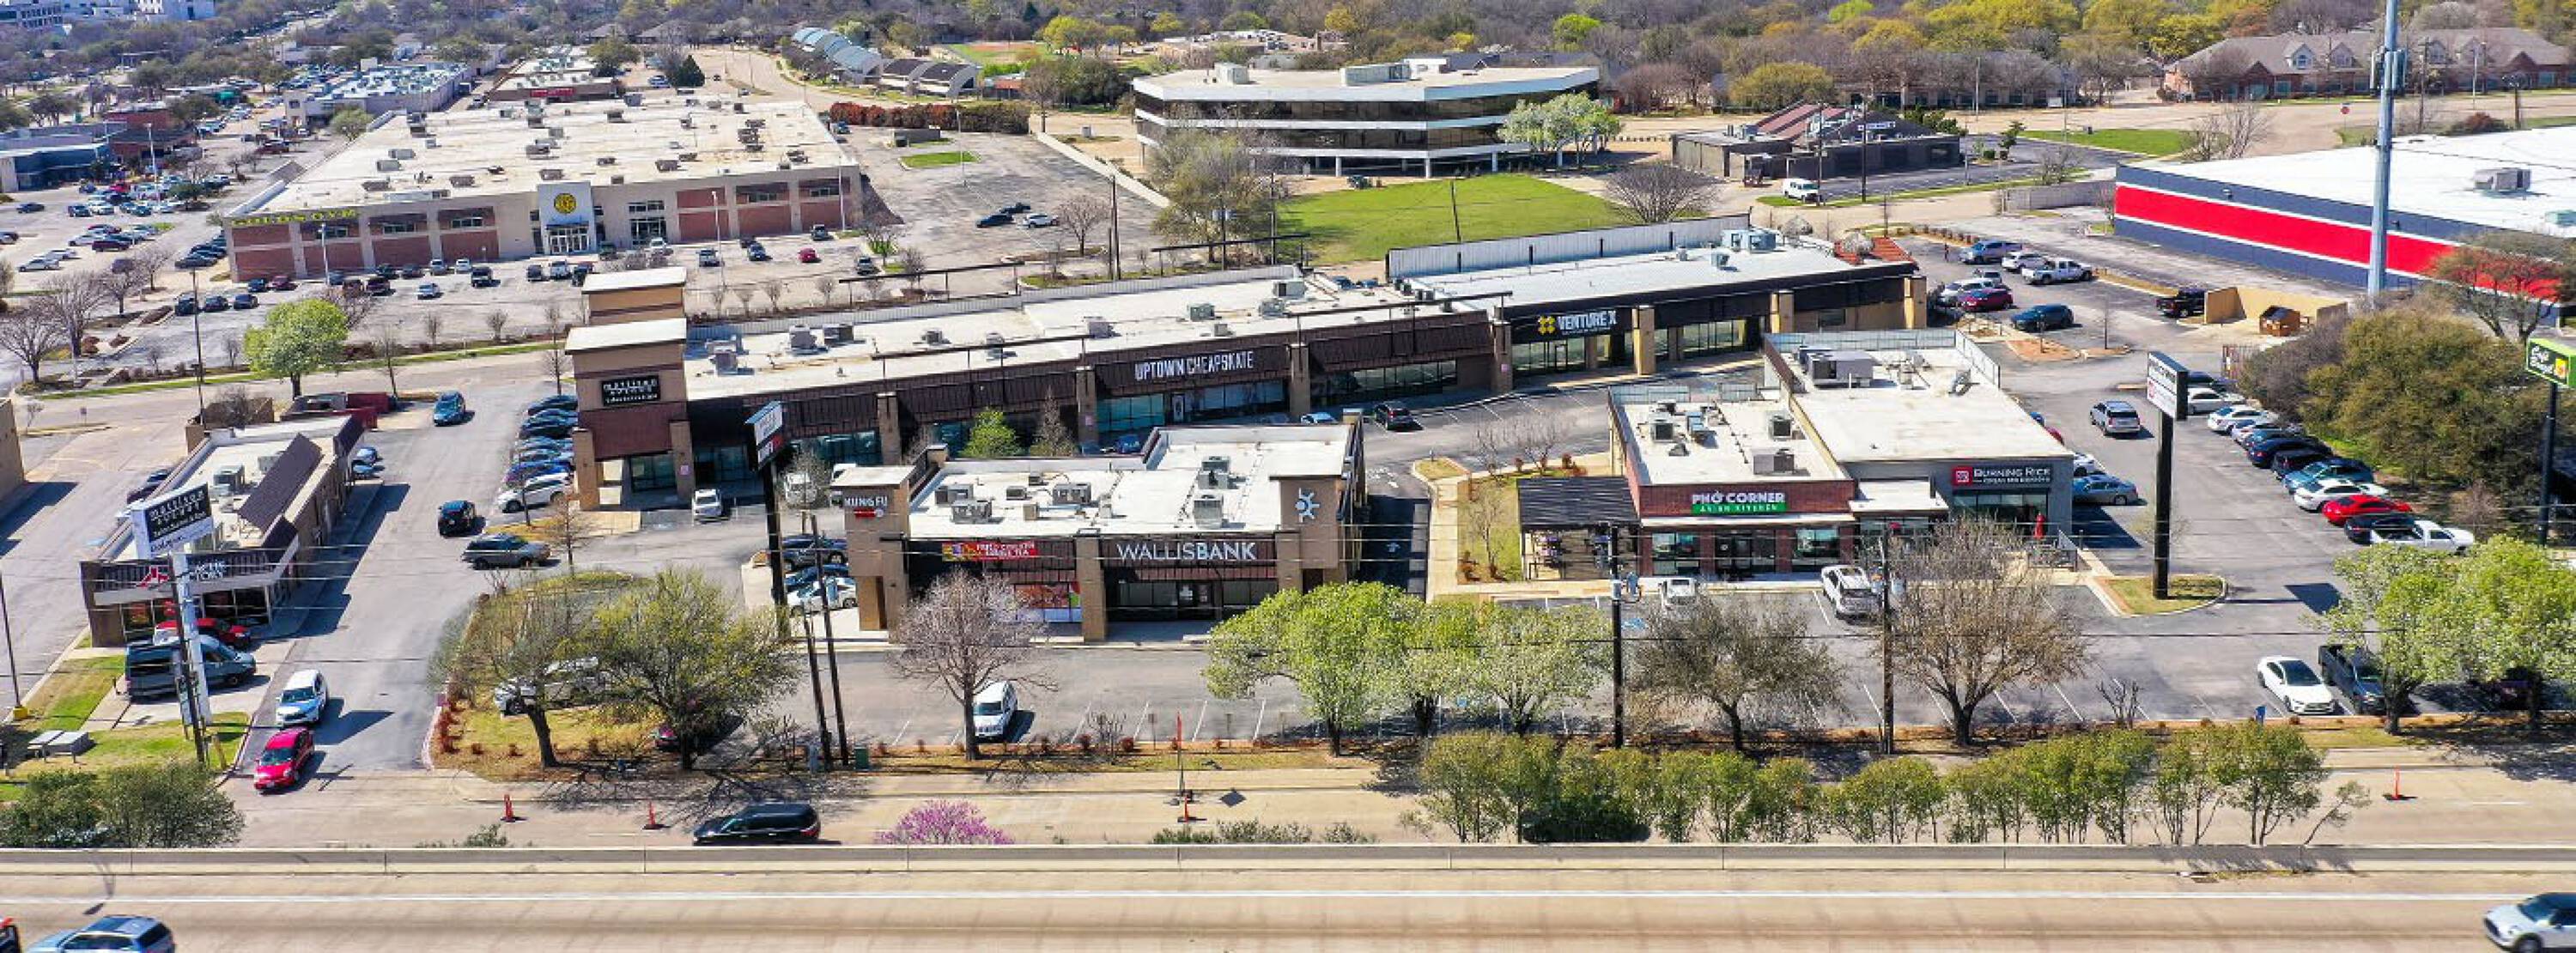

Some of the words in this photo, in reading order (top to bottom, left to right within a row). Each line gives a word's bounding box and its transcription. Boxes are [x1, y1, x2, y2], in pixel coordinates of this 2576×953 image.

[1557, 312, 1607, 330] VENTURE
[1608, 310, 1617, 325] X
[1134, 359, 1184, 381] UPTOWN
[1186, 351, 1254, 374] CHEAPSKATE
[876, 495, 888, 507] FU
[1726, 493, 1785, 503] CORNER
